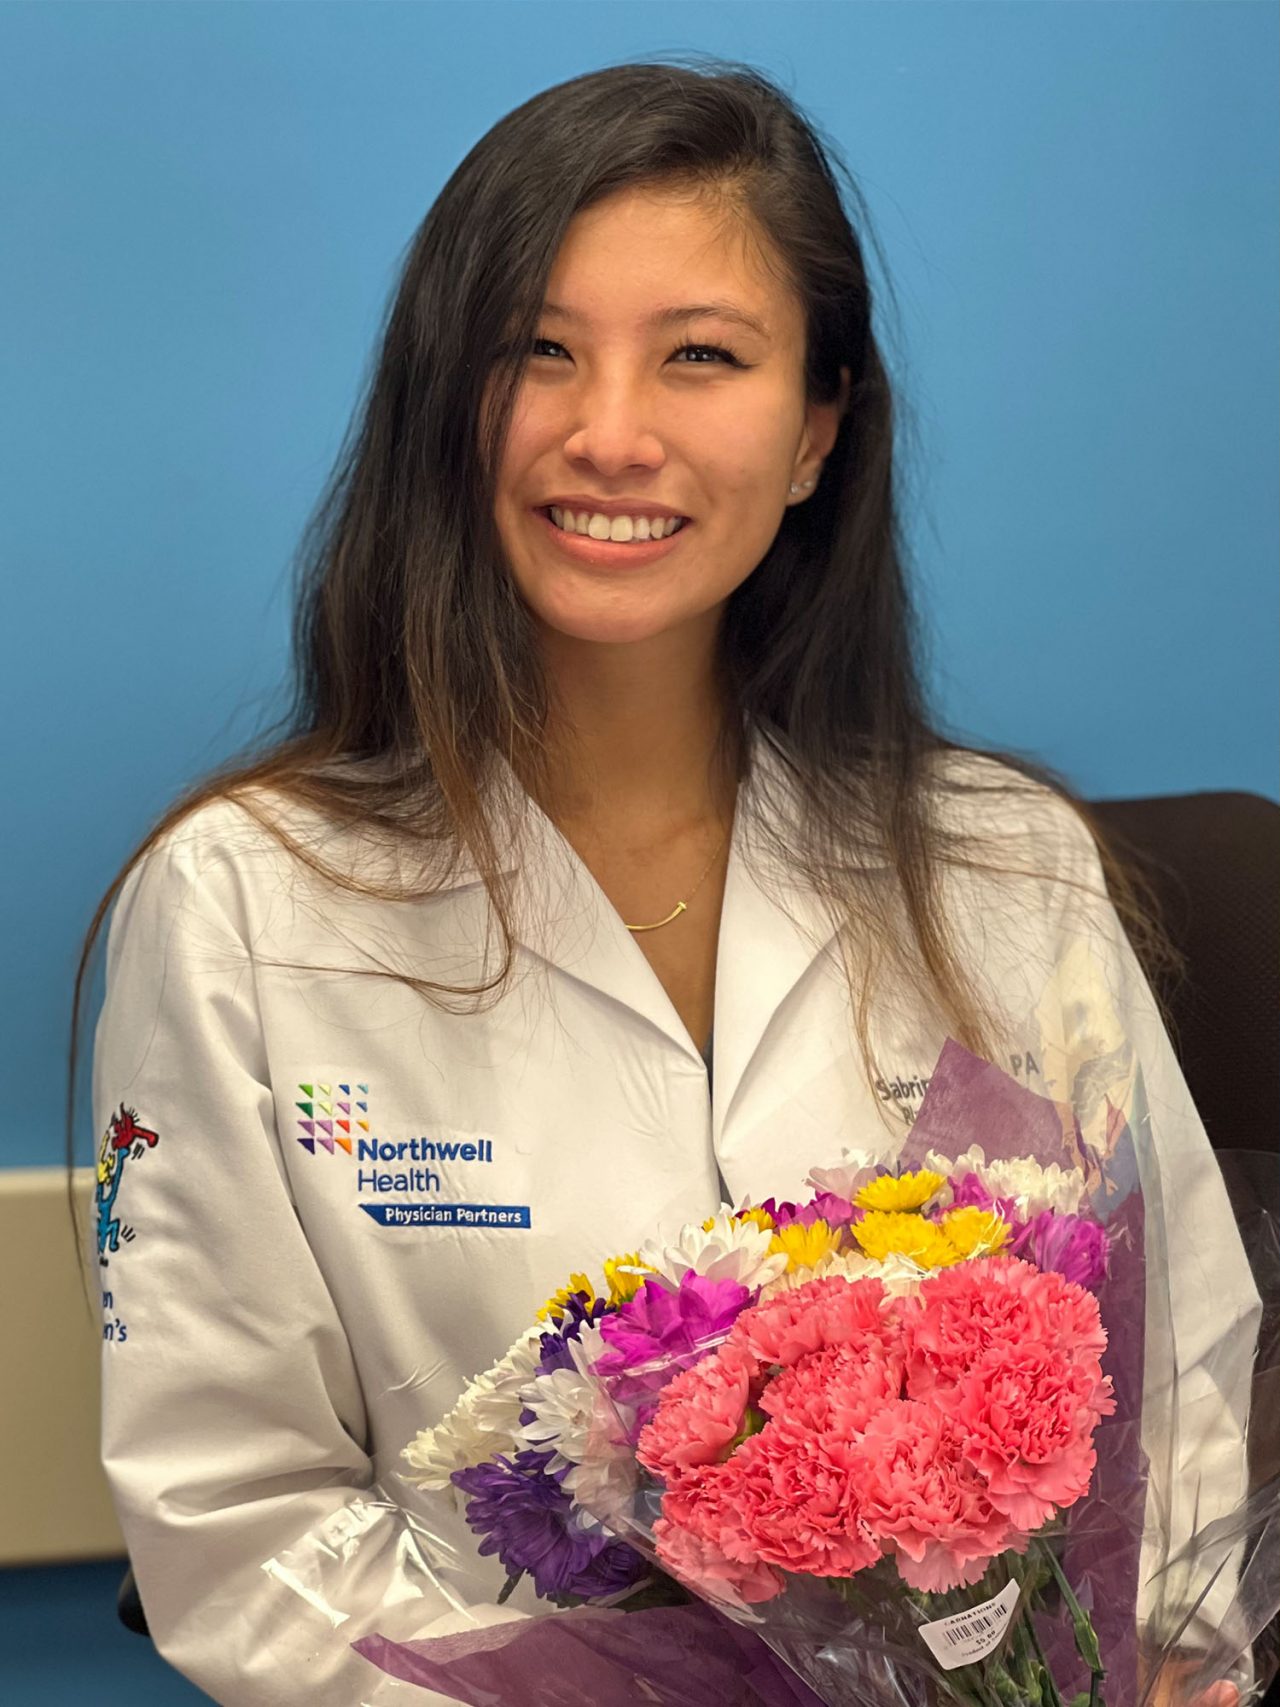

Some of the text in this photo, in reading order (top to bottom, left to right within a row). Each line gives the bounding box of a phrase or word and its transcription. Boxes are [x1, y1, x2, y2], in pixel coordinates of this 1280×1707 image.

[1009, 1051, 1040, 1076] PA
[357, 1137, 493, 1163] Northwell
[357, 1168, 440, 1192] Health
[385, 1206, 522, 1225] Physician Partners
